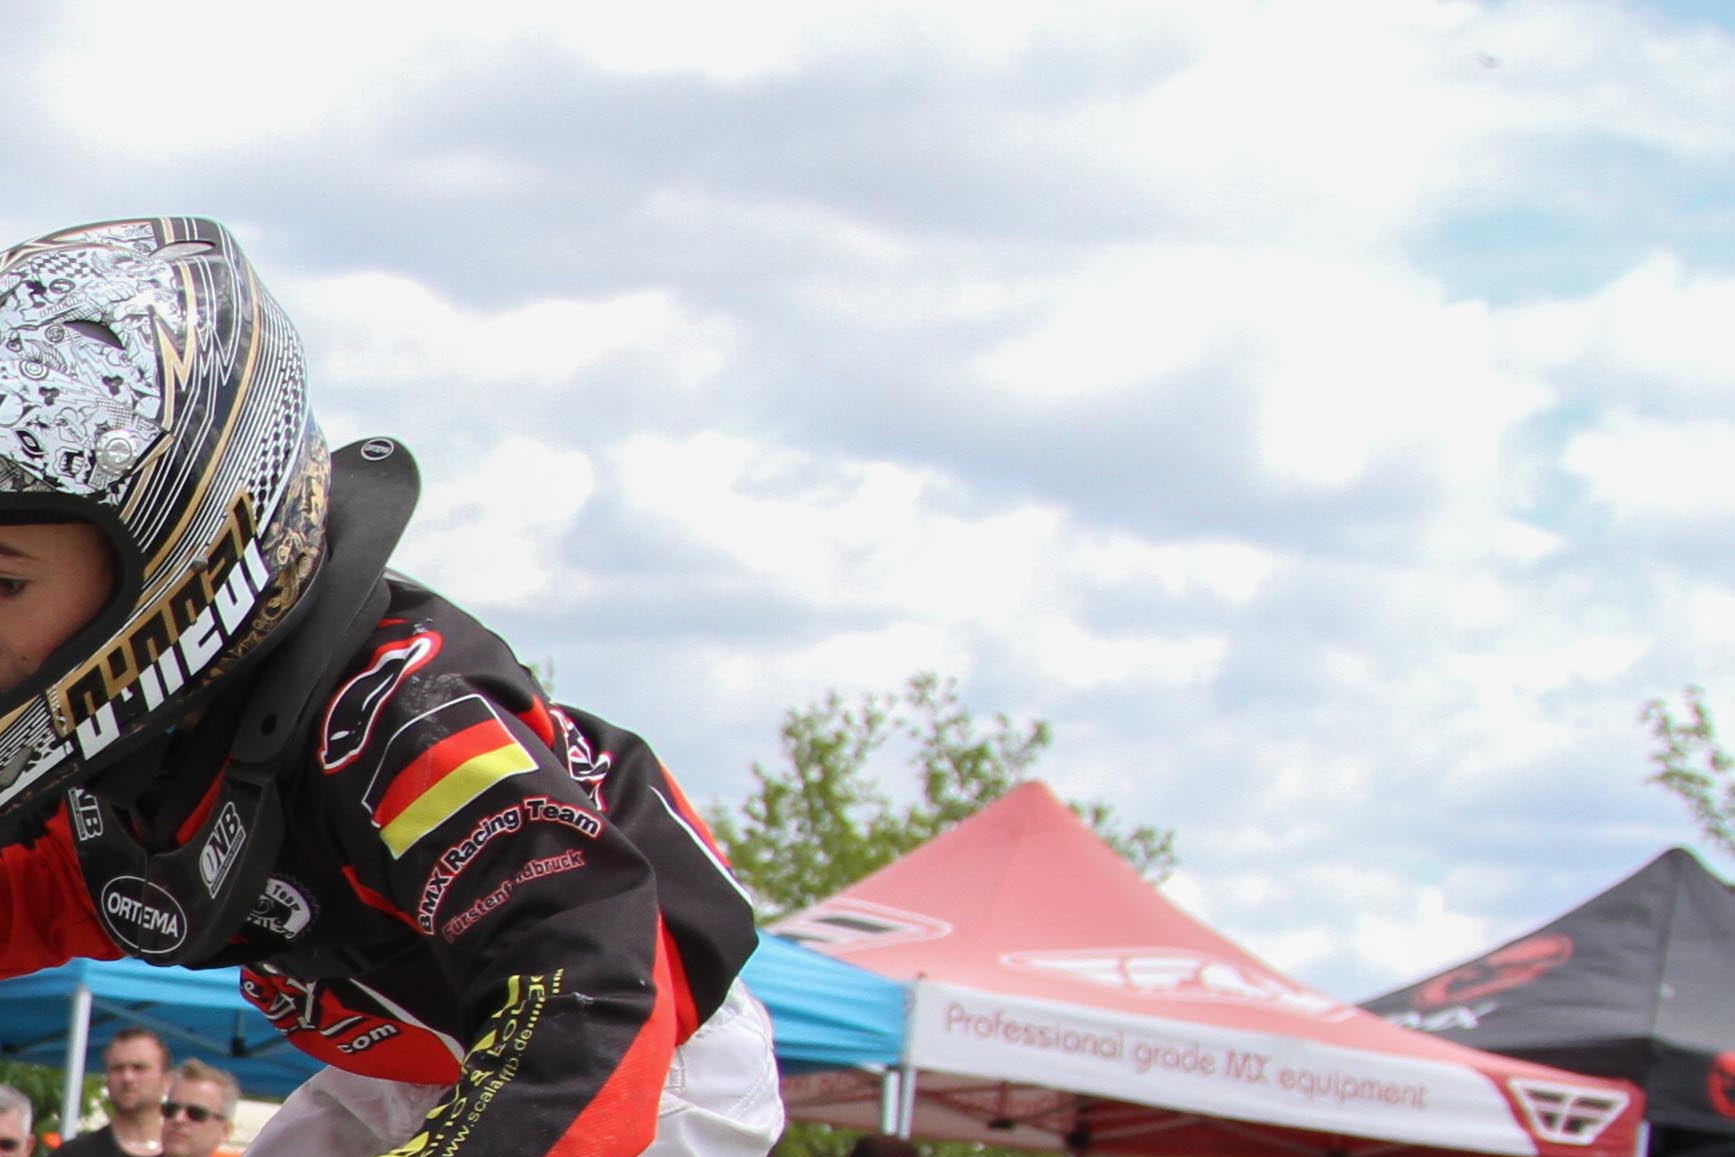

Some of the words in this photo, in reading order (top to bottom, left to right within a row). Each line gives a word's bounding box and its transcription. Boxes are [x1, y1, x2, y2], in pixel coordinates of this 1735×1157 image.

[106, 891, 179, 938] ORTEMA
[418, 867, 453, 935] BMX
[441, 805, 523, 874] Racing
[523, 795, 606, 839] Team
[442, 849, 587, 944] Fürstenfdbruck
[944, 1000, 1125, 1060] Professional
[1133, 1041, 1217, 1076] grade
[1223, 1048, 1270, 1085] MX
[1278, 1064, 1428, 1109] equipment
